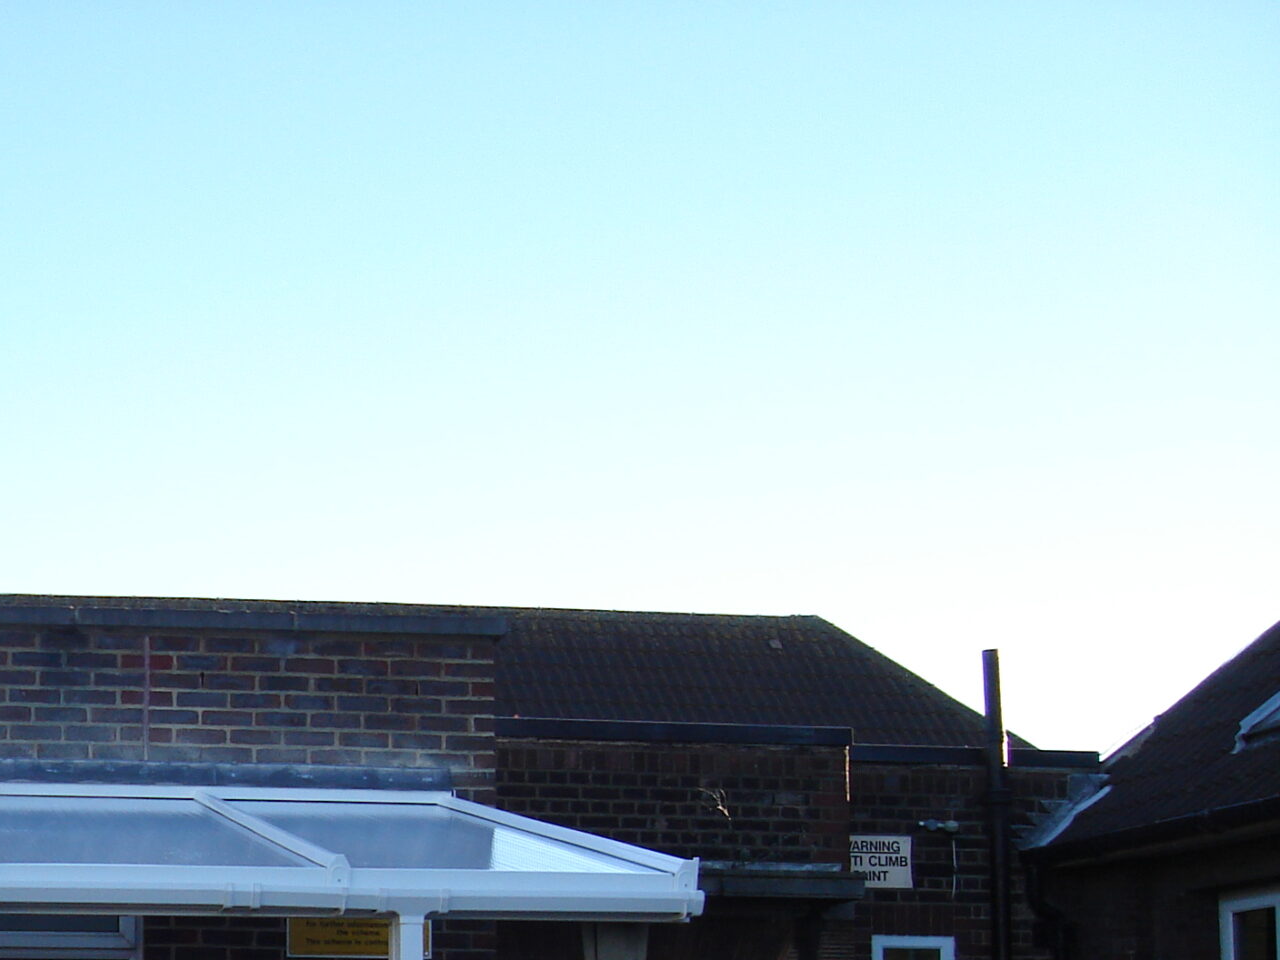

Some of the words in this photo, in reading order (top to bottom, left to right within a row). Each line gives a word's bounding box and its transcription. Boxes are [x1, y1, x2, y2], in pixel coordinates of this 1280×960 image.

[851, 855, 863, 867] TI
[868, 855, 908, 867] CLIMB
[854, 870, 889, 881] INT
